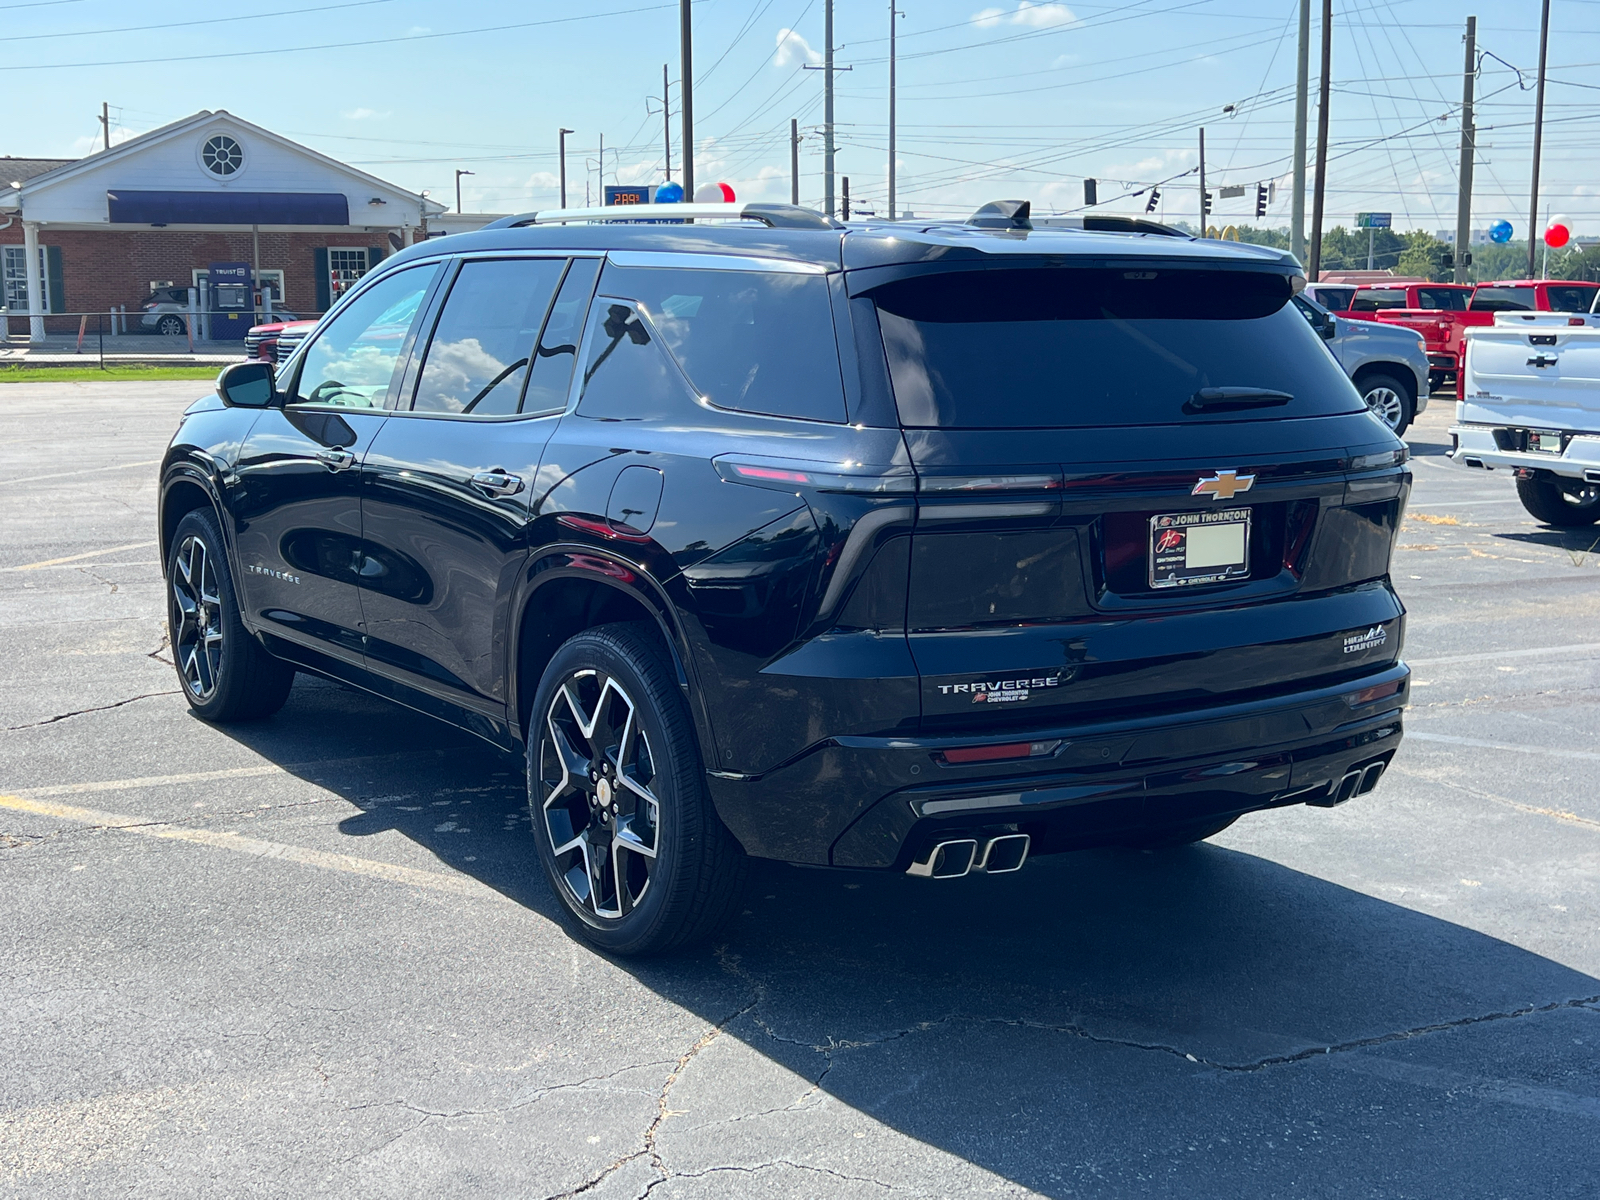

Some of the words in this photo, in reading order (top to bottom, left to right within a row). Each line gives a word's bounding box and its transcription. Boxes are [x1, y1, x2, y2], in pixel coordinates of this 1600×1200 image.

[1175, 514, 1200, 525] JOHN
[1201, 510, 1247, 522] THORNTON
[249, 565, 301, 585] TRAVERSE
[1343, 633, 1367, 646] HIGH
[1343, 636, 1387, 654] COUNTRY
[937, 676, 1059, 695] TRAVERSE
[1001, 689, 1029, 697] THORNTON
[987, 695, 1019, 703] CHEVROLET
